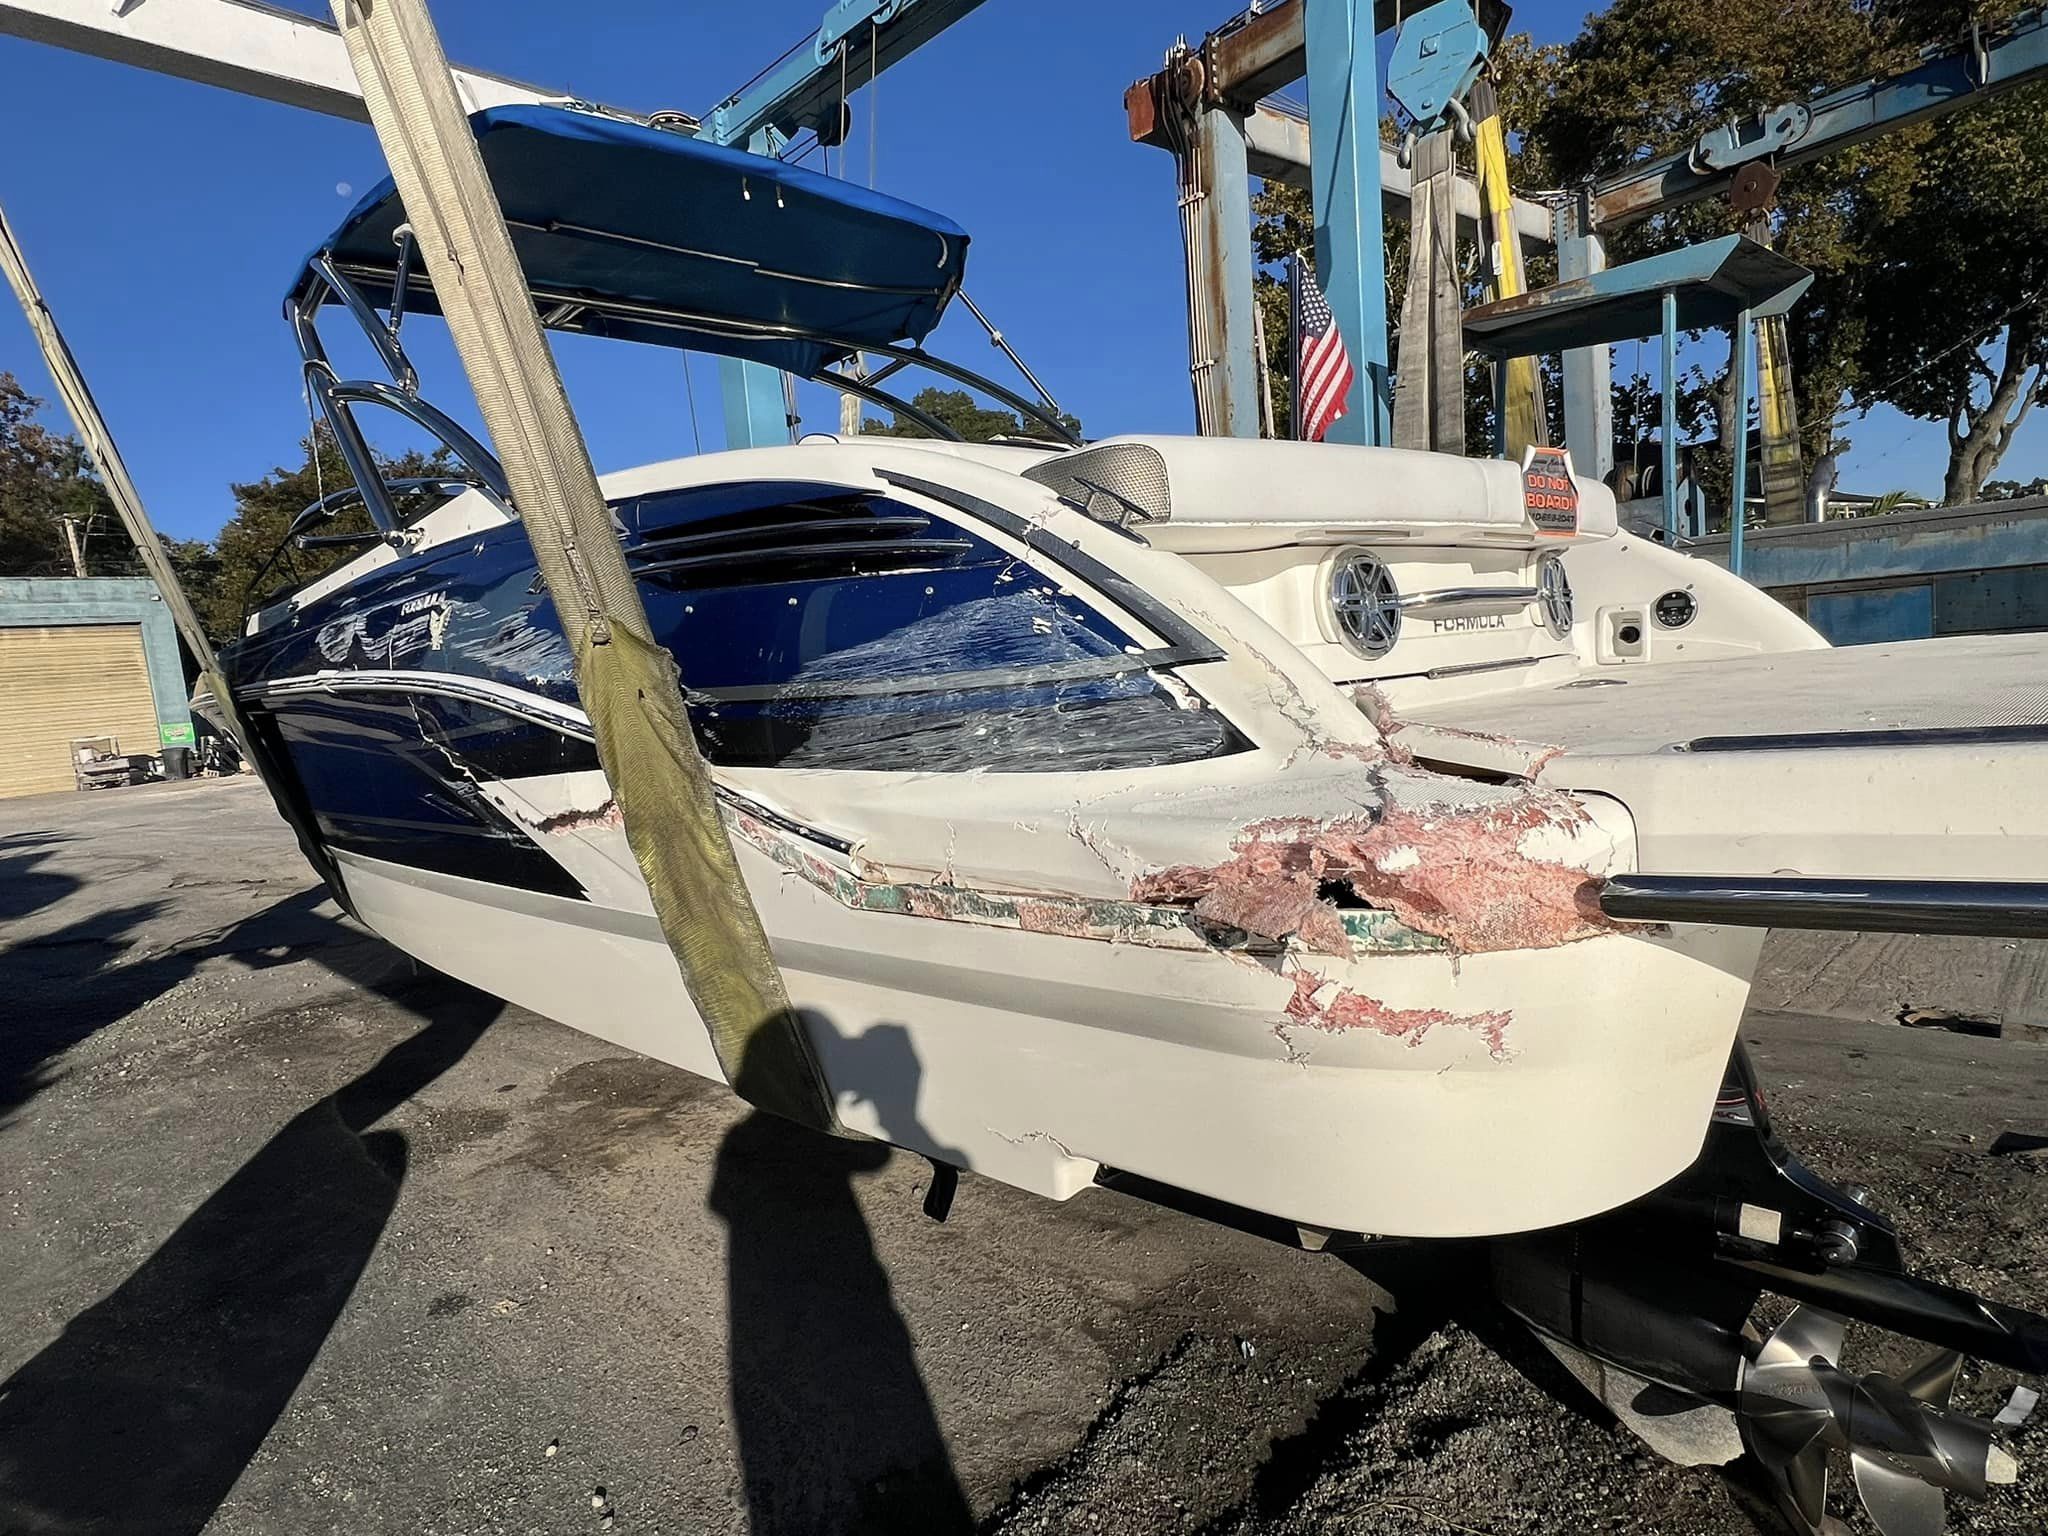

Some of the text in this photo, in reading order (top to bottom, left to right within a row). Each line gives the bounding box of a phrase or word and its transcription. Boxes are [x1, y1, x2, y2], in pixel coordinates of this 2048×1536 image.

[1527, 474, 1570, 492] DO NOT
[1526, 492, 1573, 510] BOARD!
[1434, 614, 1505, 633] FORMULA
